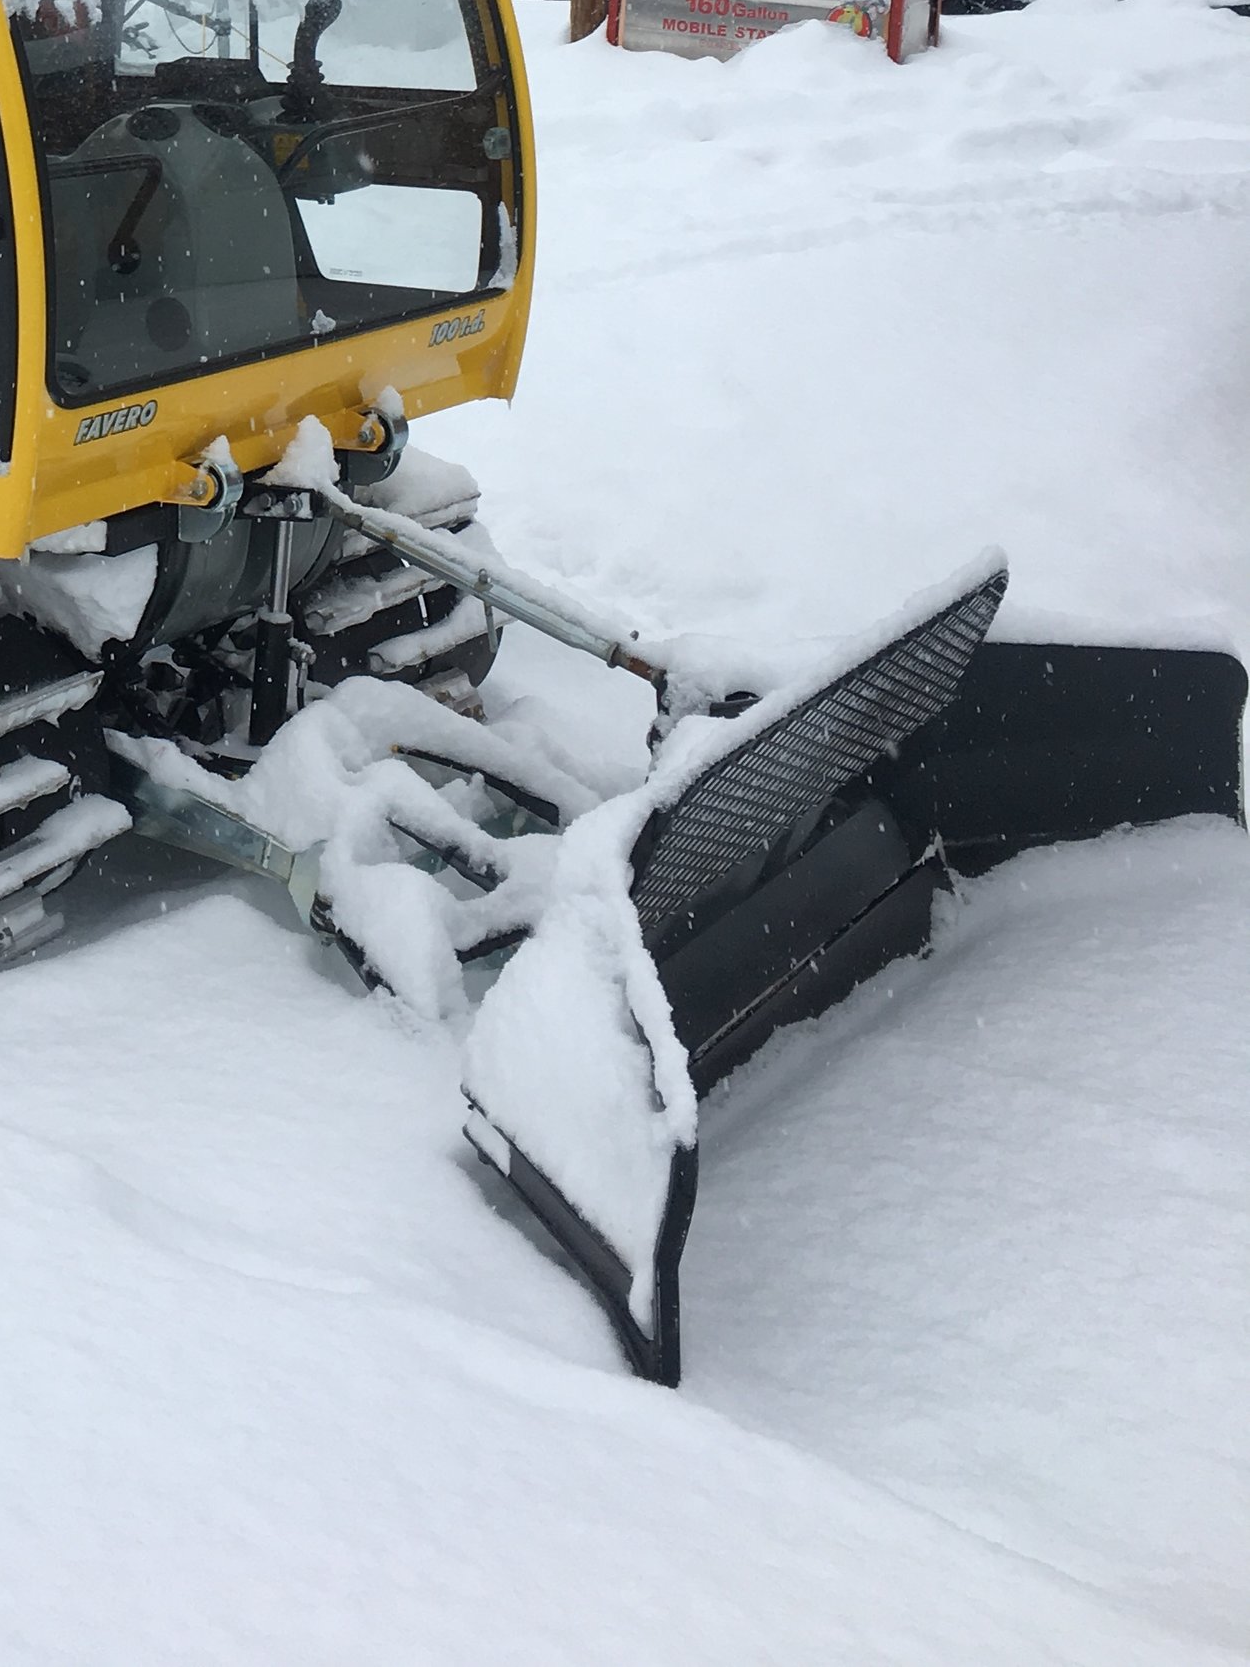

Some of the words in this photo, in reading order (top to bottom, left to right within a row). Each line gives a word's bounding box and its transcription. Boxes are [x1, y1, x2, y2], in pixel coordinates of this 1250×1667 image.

[732, 3, 789, 21] Gallon
[662, 18, 727, 37] MOBILE
[428, 317, 461, 347] 100
[73, 400, 158, 446] FAVERO
